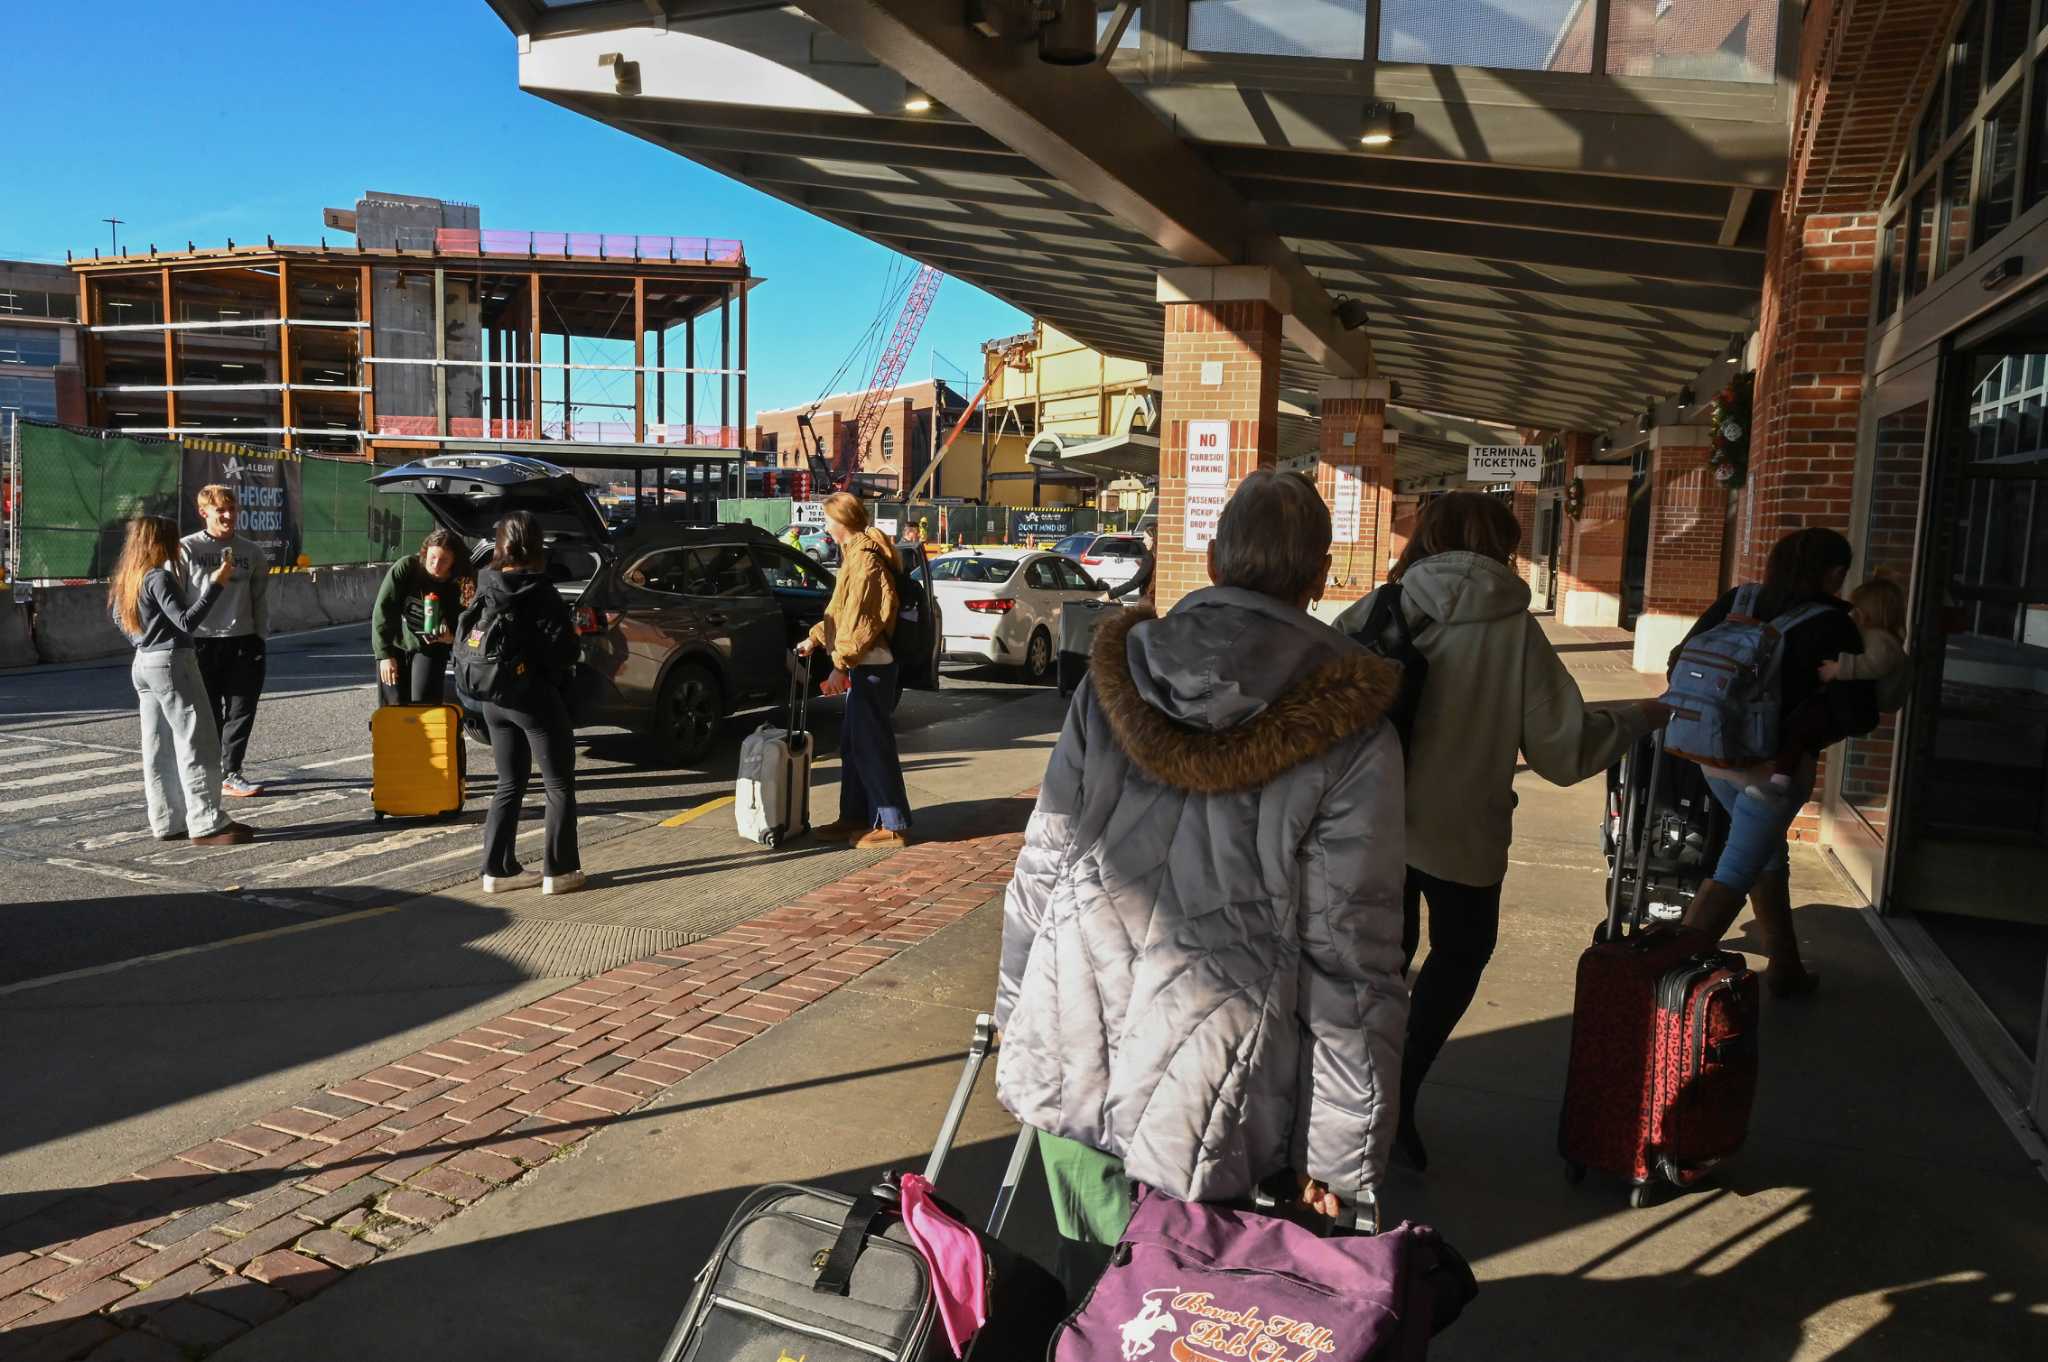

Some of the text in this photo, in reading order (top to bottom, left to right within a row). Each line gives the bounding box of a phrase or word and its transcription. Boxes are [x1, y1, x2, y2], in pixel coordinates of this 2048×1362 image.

[1200, 433, 1216, 447] NO
[1475, 447, 1536, 457] TERMINAL
[1473, 458, 1537, 467] TICKETING
[246, 463, 275, 473] ALBANY
[1191, 465, 1222, 473] PARKING
[1188, 496, 1225, 505] PASSENGER
[1209, 521, 1217, 529] OF
[1171, 1292, 1336, 1353] Beverly Hills
[1186, 1320, 1248, 1356] Polo
